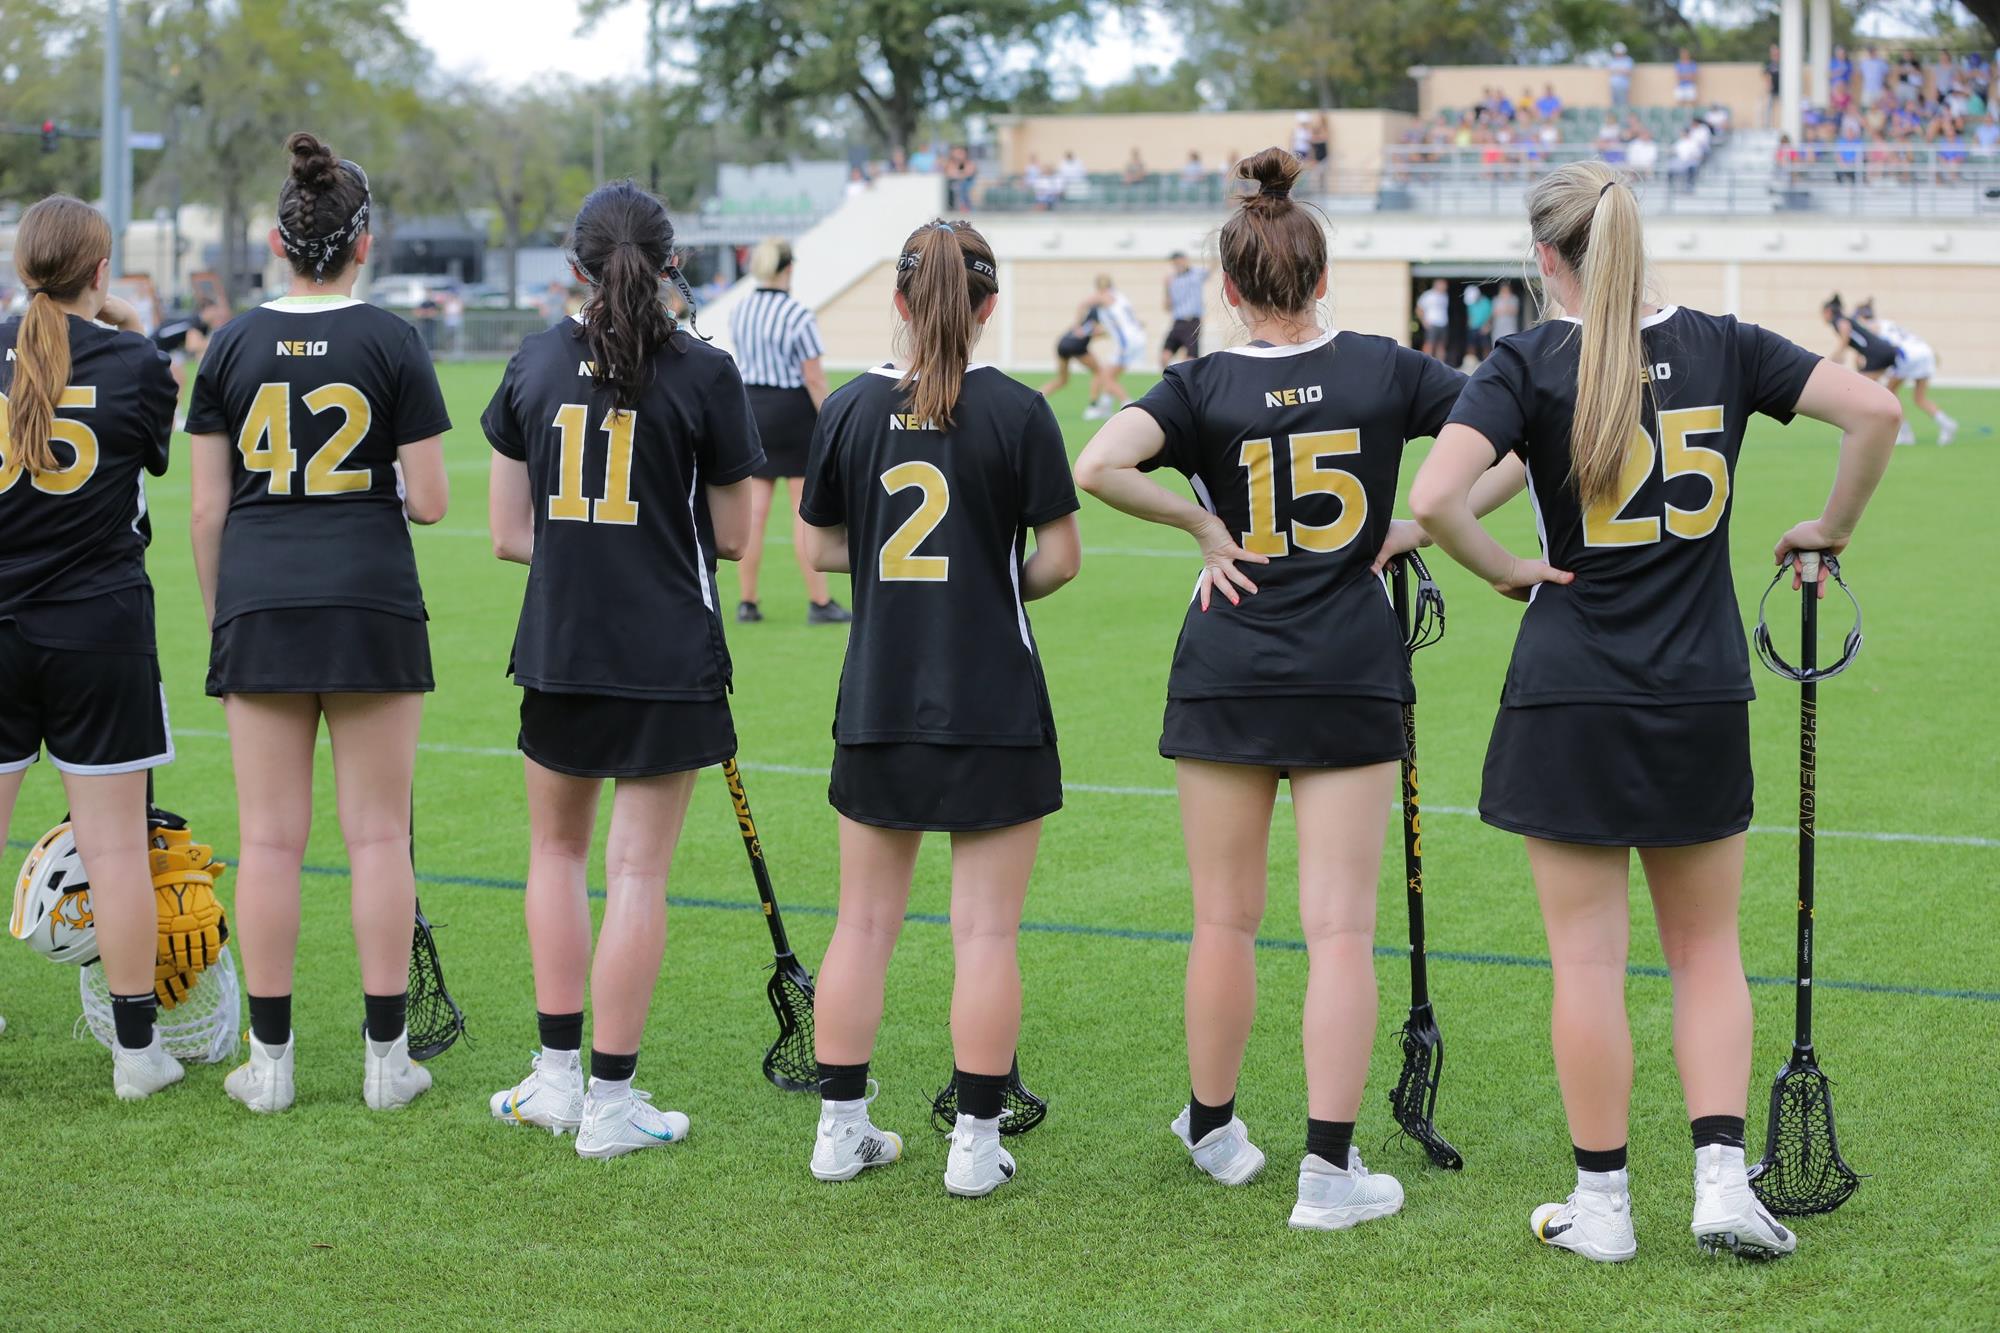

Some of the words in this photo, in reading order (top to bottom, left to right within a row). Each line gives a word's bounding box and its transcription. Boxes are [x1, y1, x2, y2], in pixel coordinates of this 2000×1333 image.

[973, 260, 995, 278] STX
[275, 340, 329, 356] NE10
[1264, 384, 1324, 408] NE10
[237, 382, 373, 496] 42
[548, 403, 640, 526] 11
[1238, 427, 1369, 558] 15
[1582, 404, 1730, 548] 25
[878, 460, 951, 582] 2
[1799, 698, 1818, 839] ADELPHI
